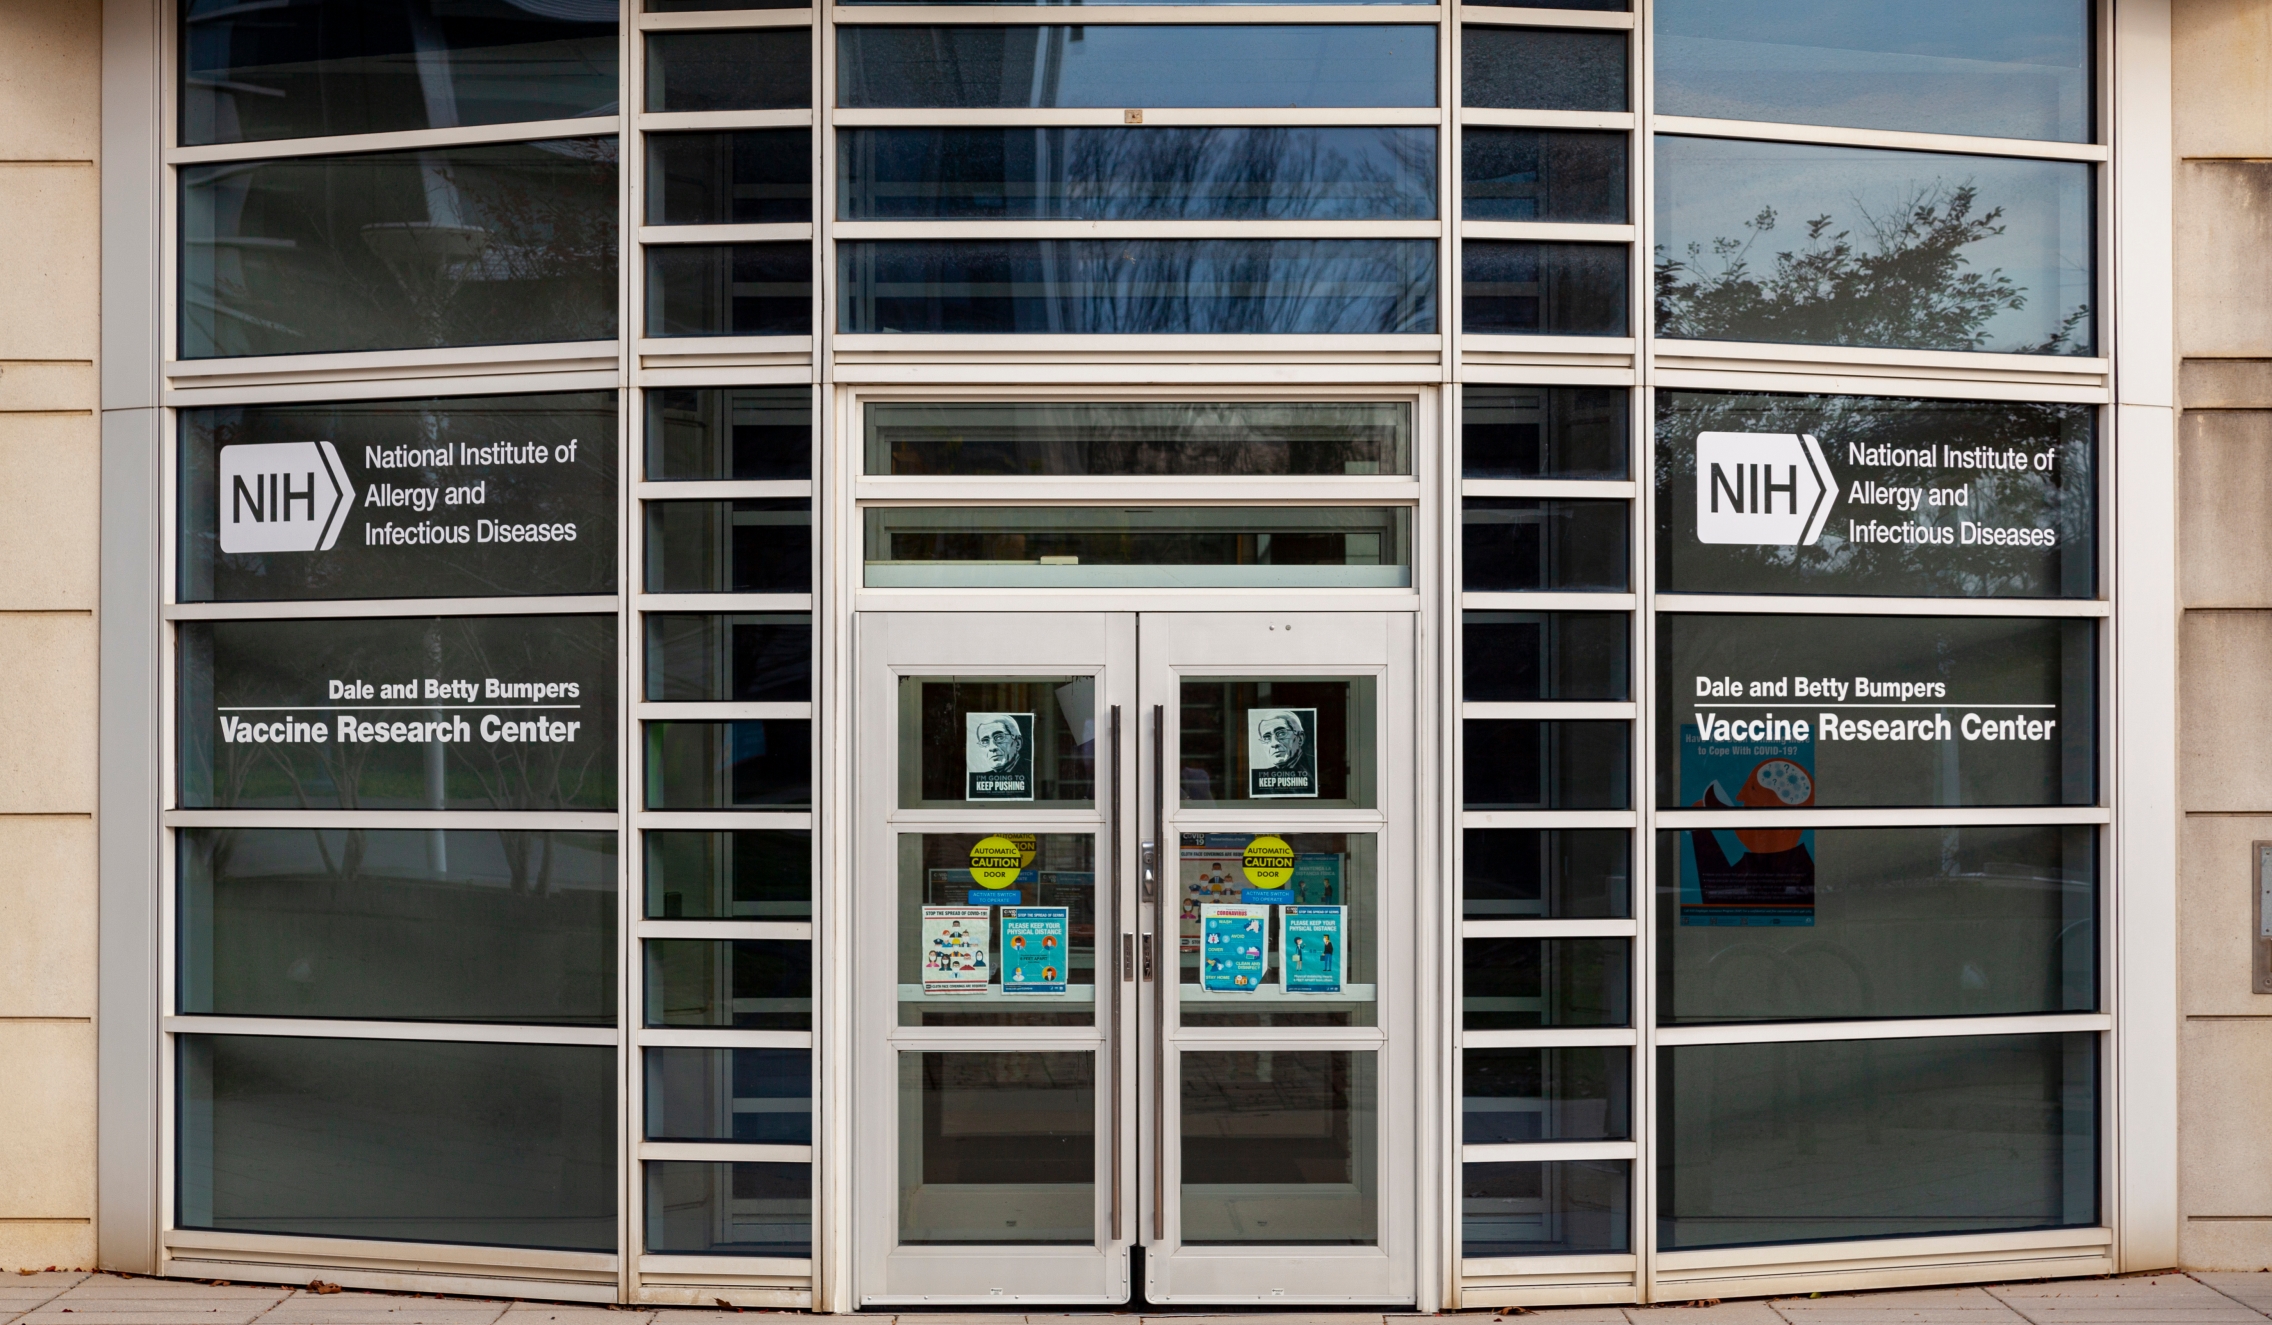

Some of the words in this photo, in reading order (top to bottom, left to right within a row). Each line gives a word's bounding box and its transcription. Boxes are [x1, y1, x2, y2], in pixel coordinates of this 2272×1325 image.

[365, 442, 454, 469] National
[460, 440, 549, 466] Institute
[554, 438, 578, 463] of
[1849, 441, 1937, 468] National
[1944, 444, 2028, 471] Institute
[2033, 447, 2055, 471] of
[232, 471, 315, 524] NIH
[364, 482, 439, 512] Allergy
[444, 480, 485, 505] and
[1710, 462, 1798, 515] NIH
[1848, 480, 1923, 512] Allergy
[1928, 483, 1969, 507] and
[365, 520, 471, 546] Infectious
[477, 519, 577, 543] Diseases
[1849, 519, 1955, 545] Infectious
[1960, 520, 2056, 547] Diseases
[329, 679, 375, 700] Dale
[380, 678, 418, 700] and
[424, 678, 480, 703] Betty
[485, 678, 580, 703] Bumpers
[1696, 676, 1743, 697] Dale
[1749, 676, 1788, 697] and
[1794, 676, 1849, 702] Betty
[1855, 677, 1946, 702] Bumpers
[219, 715, 329, 743] Vaccine
[337, 714, 471, 743] Research
[479, 714, 581, 743] Center
[1695, 712, 1810, 741] Vaccine
[1819, 713, 1952, 741] Research
[1960, 712, 2056, 741] Center
[1698, 746, 1706, 756] to
[1709, 746, 1730, 757] Cope
[1732, 746, 1751, 756] With
[1754, 746, 1798, 756] COVID-19?
[976, 781, 994, 791] KEEP
[994, 781, 1025, 791] PUSHING
[1259, 778, 1276, 788] KEEP
[1278, 777, 1308, 787] PUSHING
[972, 858, 1019, 867] CAUTION
[1245, 858, 1292, 867] CAUTION
